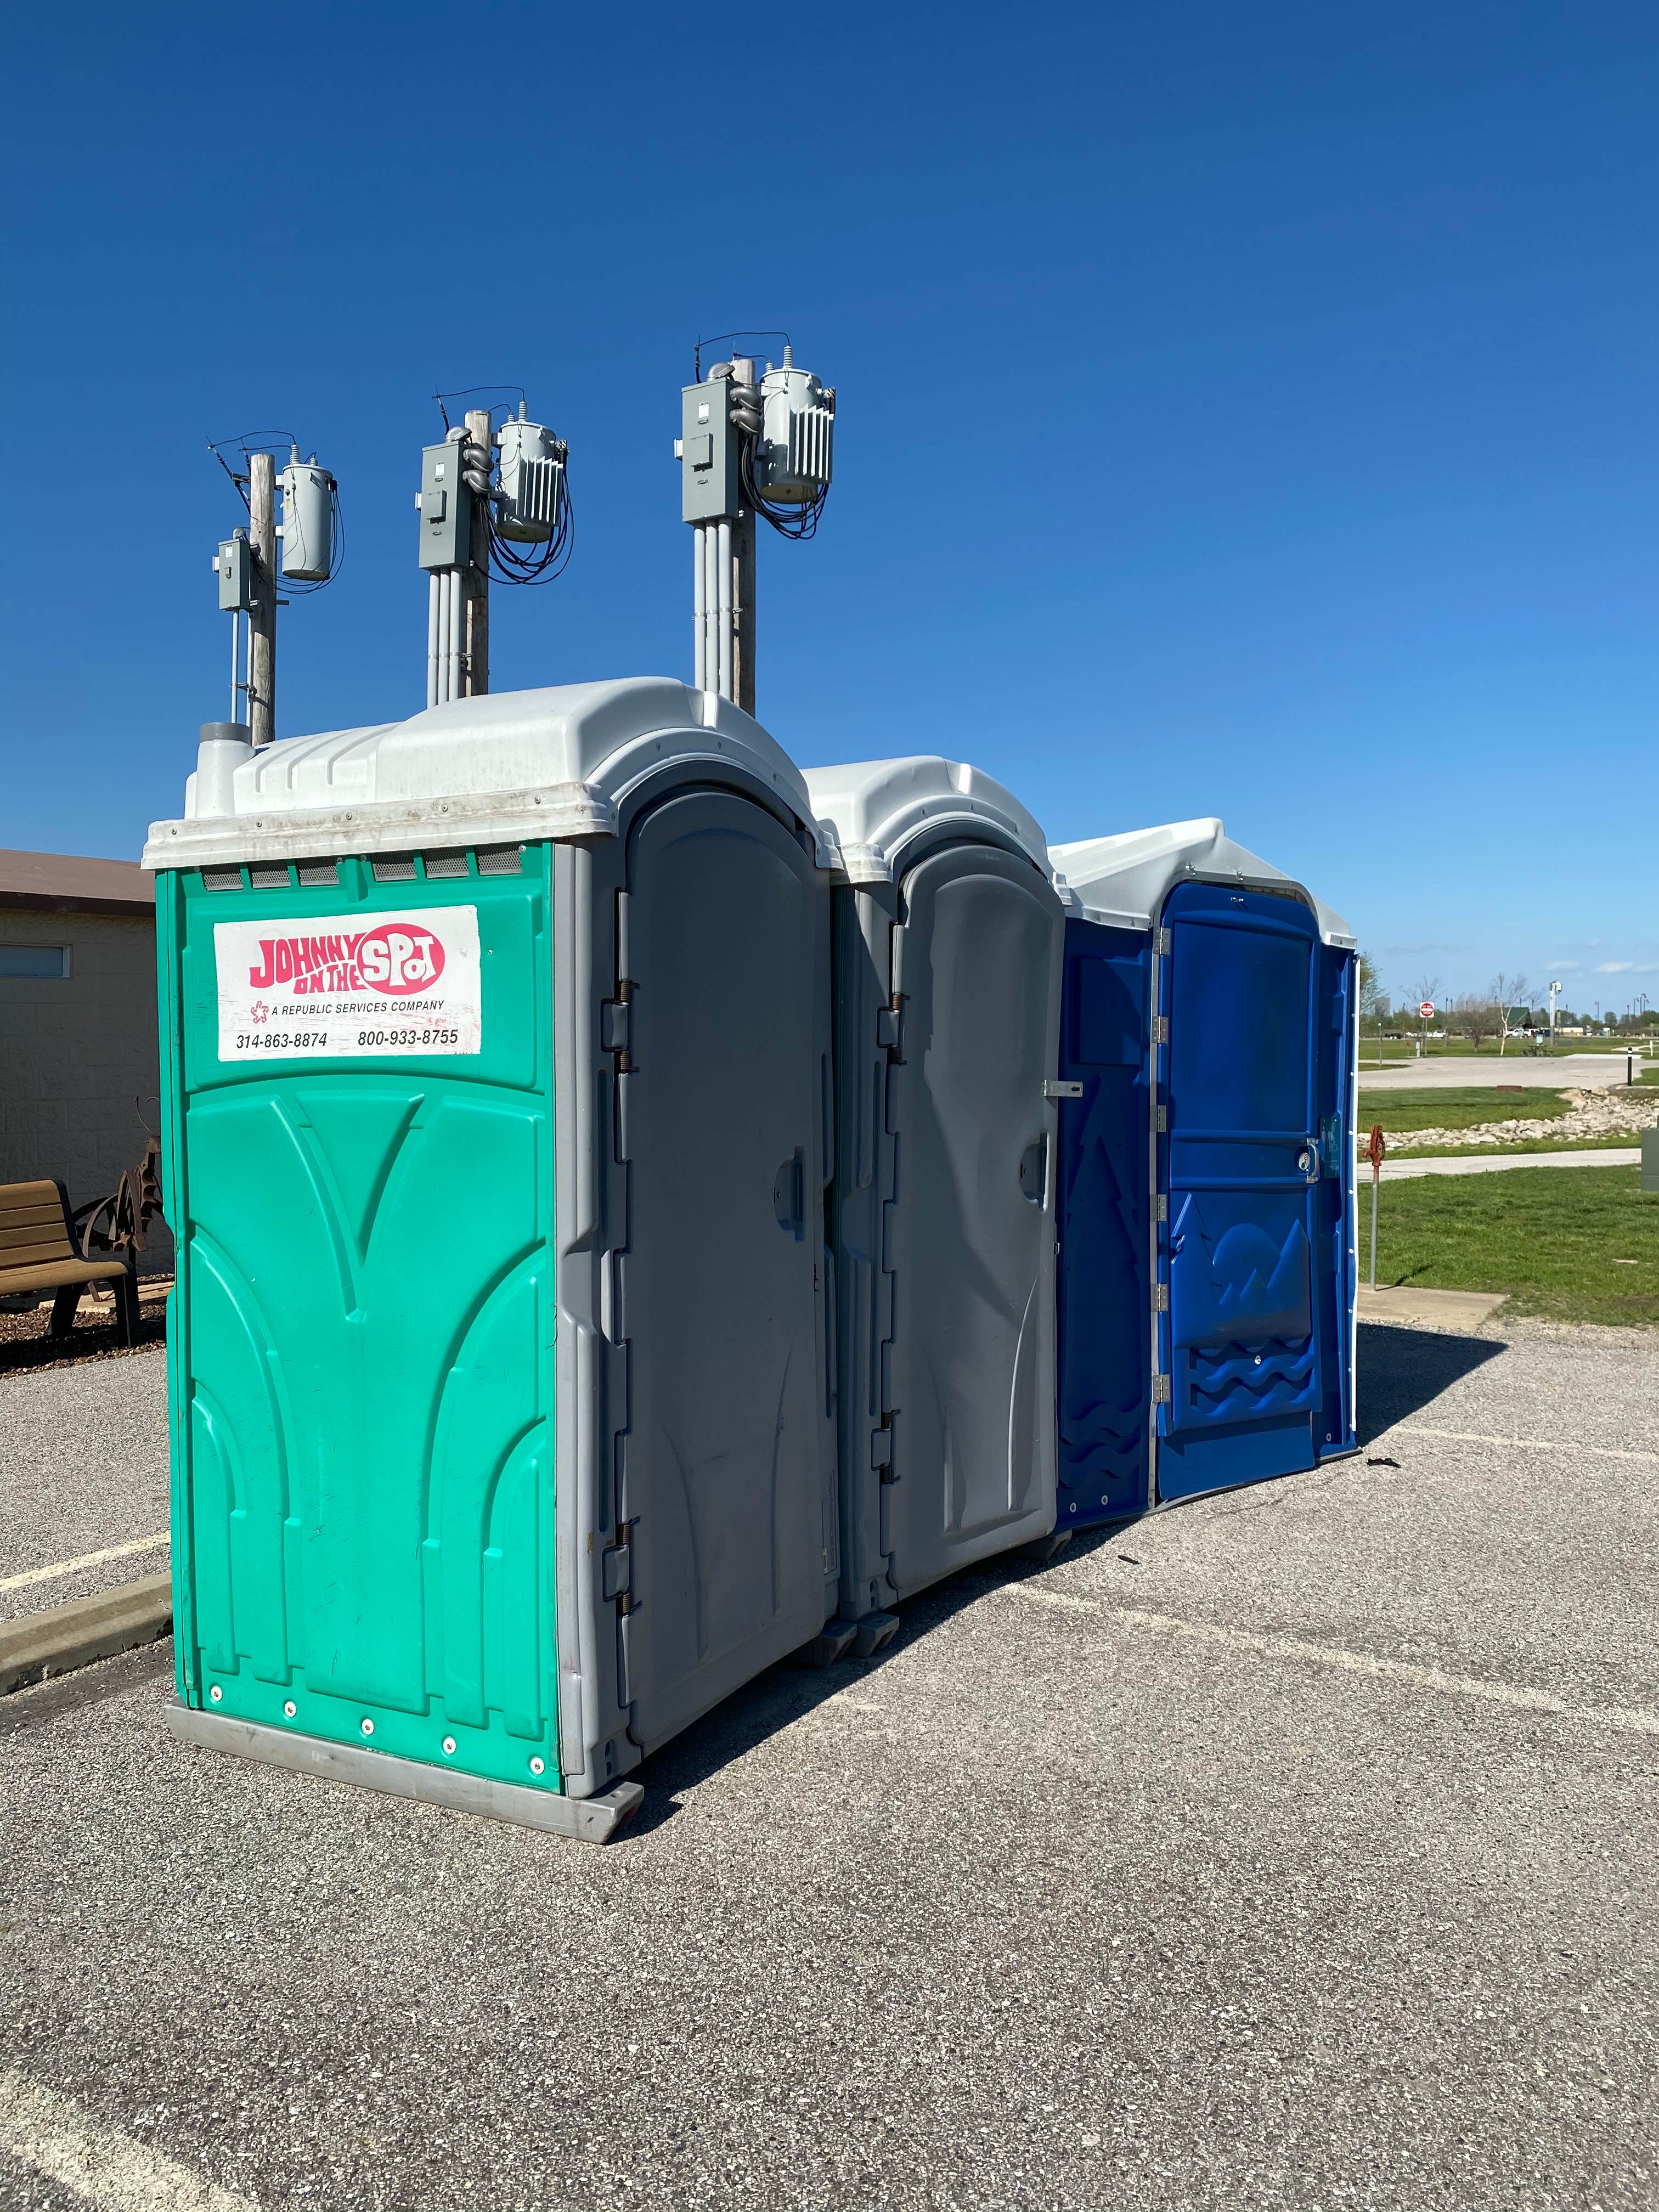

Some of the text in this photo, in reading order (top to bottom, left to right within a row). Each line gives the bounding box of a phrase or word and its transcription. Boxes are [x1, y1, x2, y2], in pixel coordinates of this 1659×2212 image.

[249, 932, 368, 988] JOHNNY
[362, 933, 437, 987] SPOT
[293, 963, 369, 995] ON THE
[271, 1000, 445, 1015] A REPUBLIC SERVICES COMPANY
[236, 1032, 328, 1049] 314-863-8874
[357, 1029, 459, 1046] 800-933-8755
